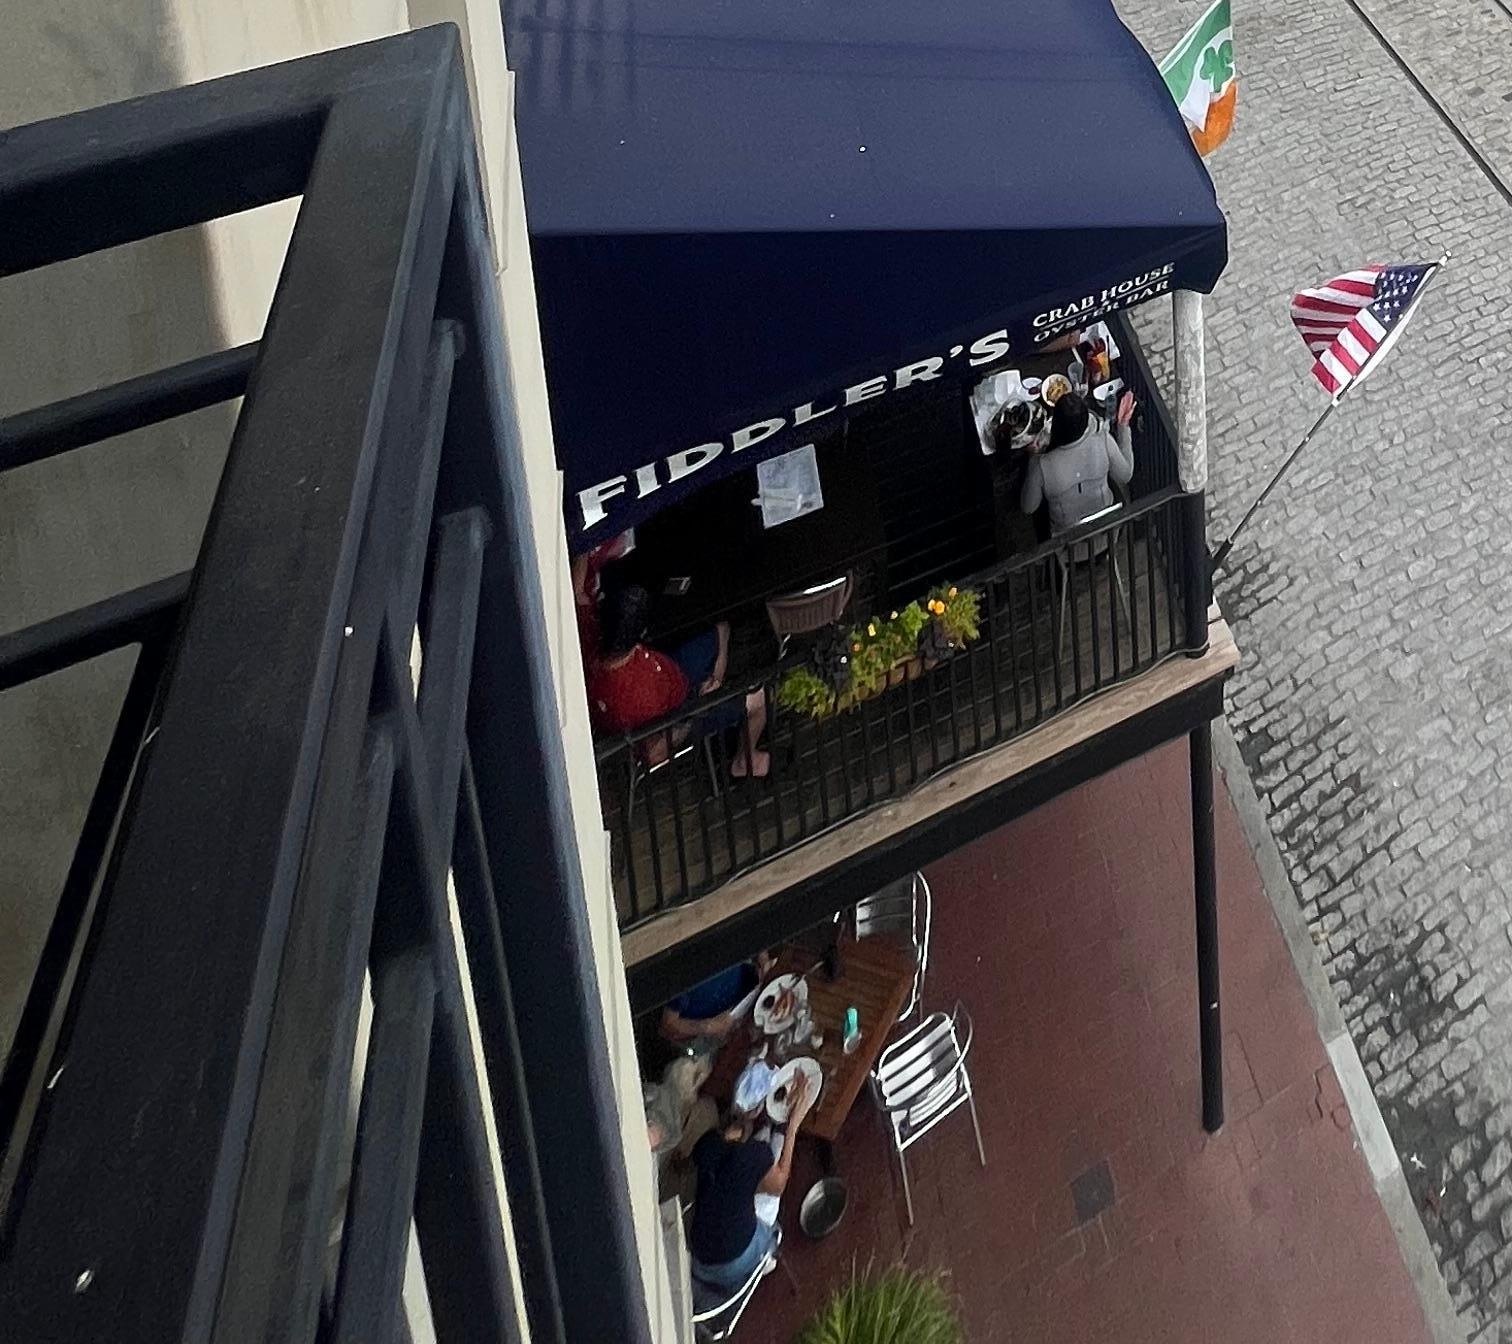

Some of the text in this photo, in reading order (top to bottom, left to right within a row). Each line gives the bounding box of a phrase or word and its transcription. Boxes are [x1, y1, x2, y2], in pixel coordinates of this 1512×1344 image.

[1032, 262, 1175, 327] CRAB HOUSE
[575, 328, 1011, 532] FIDDLER'S
